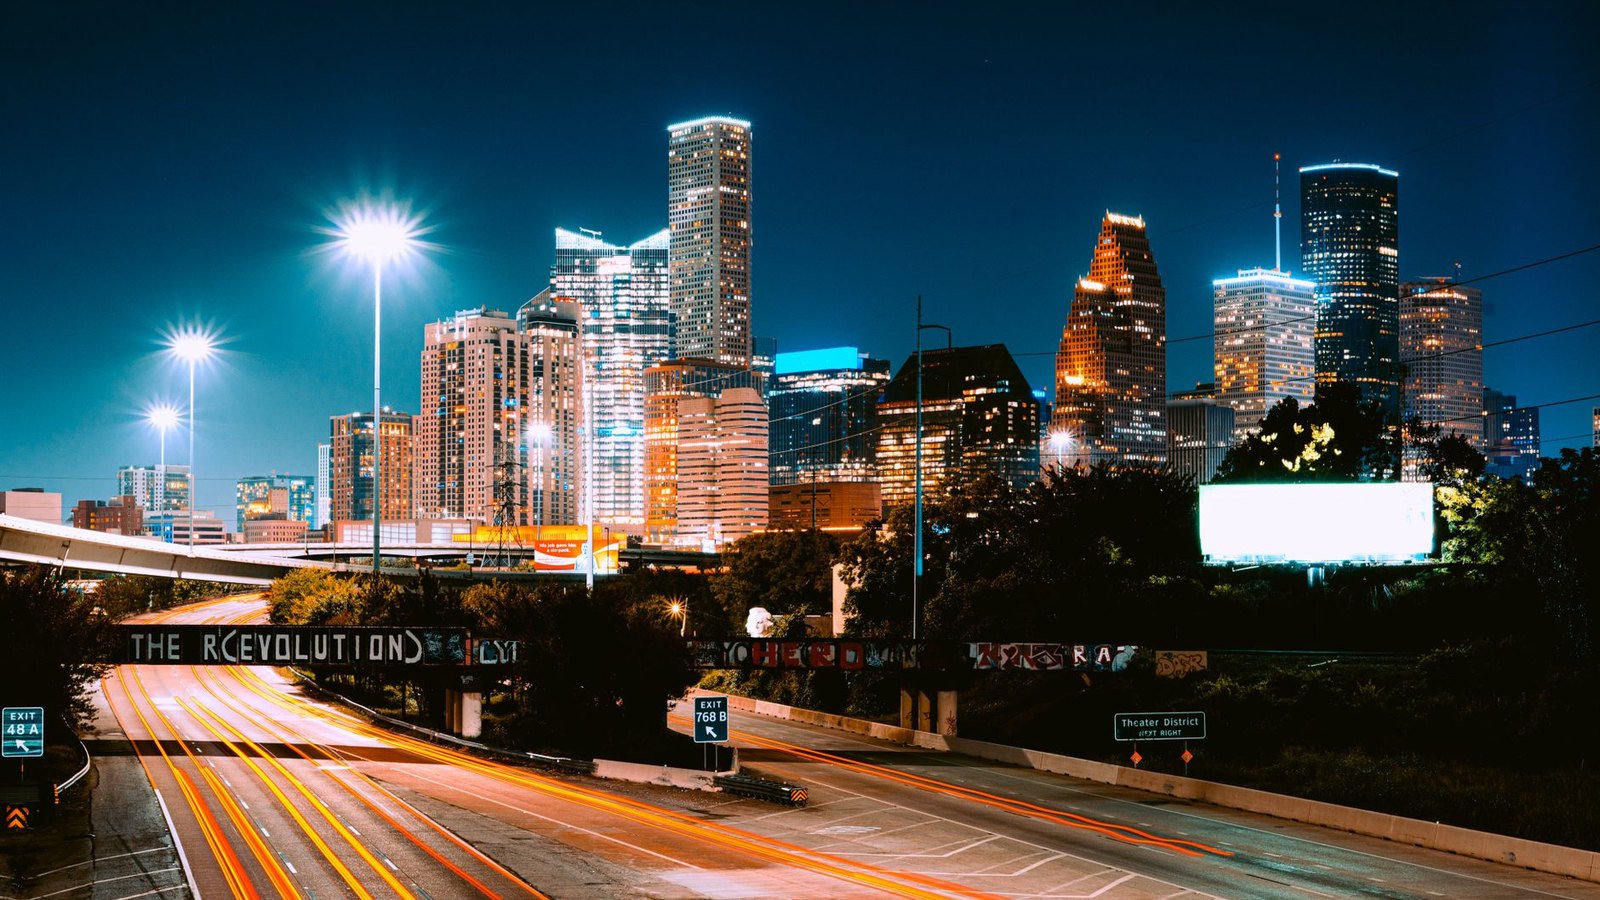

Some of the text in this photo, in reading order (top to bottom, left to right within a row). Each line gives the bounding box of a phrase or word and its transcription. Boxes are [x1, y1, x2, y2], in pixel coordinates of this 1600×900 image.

[131, 633, 180, 660] THE
[700, 700, 722, 709] EXIT
[10, 712, 36, 721] EXIT
[696, 711, 727, 722] 768 B
[1121, 717, 1199, 727] Theater District
[7, 723, 39, 735] 48 A
[1160, 729, 1182, 737] RIGHT
